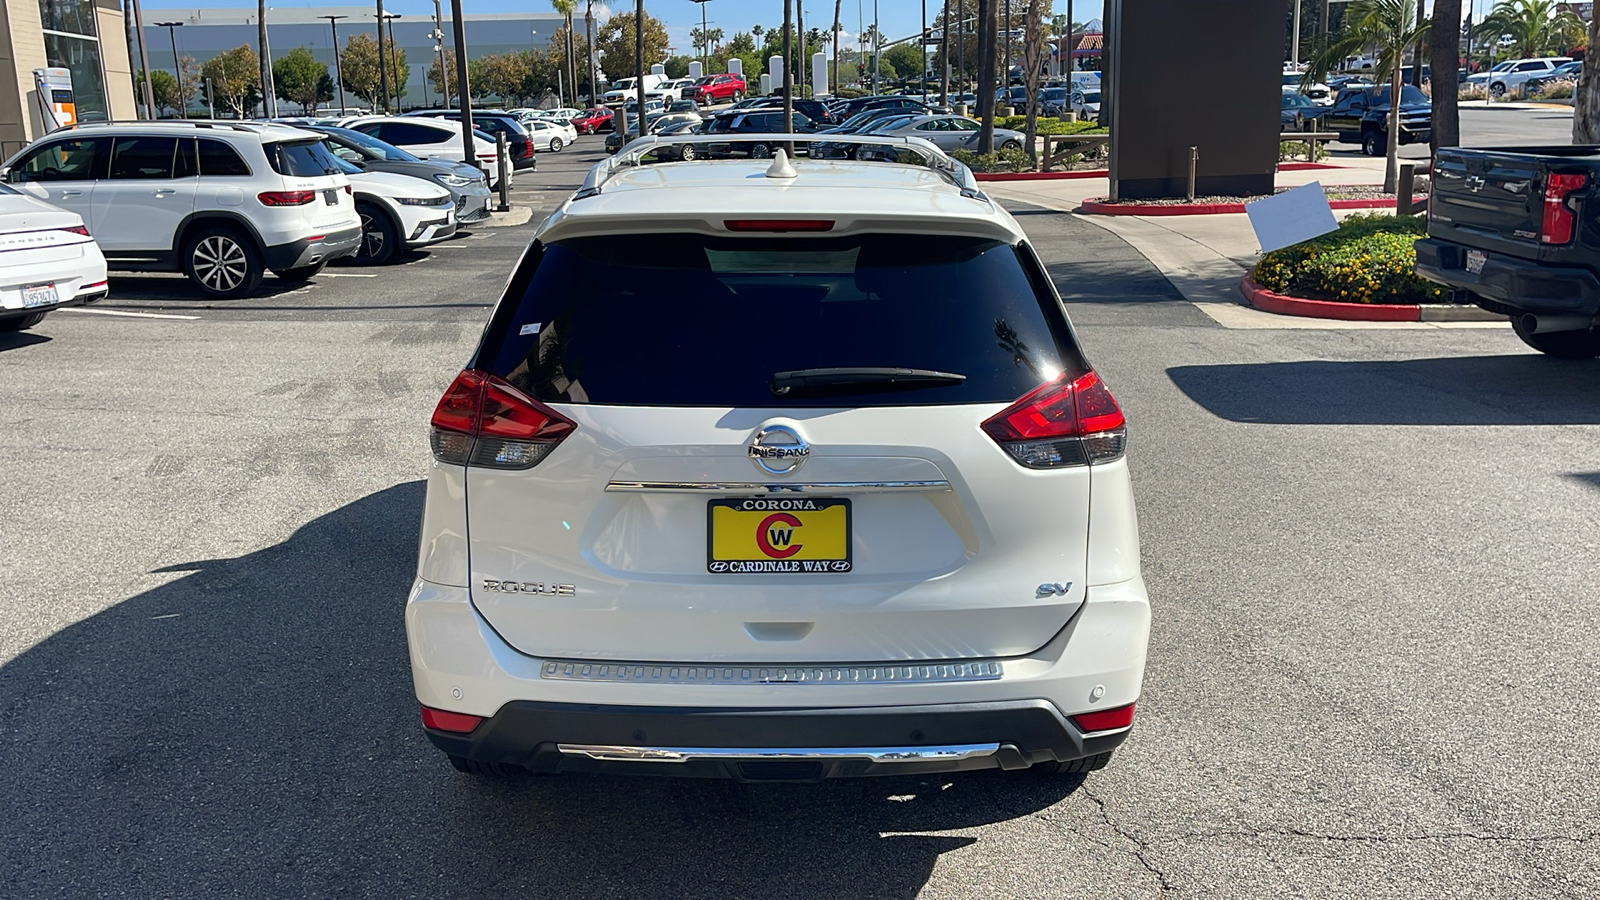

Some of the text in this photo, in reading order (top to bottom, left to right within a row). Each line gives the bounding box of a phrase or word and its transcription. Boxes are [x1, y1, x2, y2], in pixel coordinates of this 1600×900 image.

[755, 447, 803, 457] NISSAN
[742, 500, 817, 511] CORONA
[729, 561, 831, 572] CARDINALE WAY
[483, 579, 576, 597] ROGUE
[1034, 581, 1073, 599] SV
